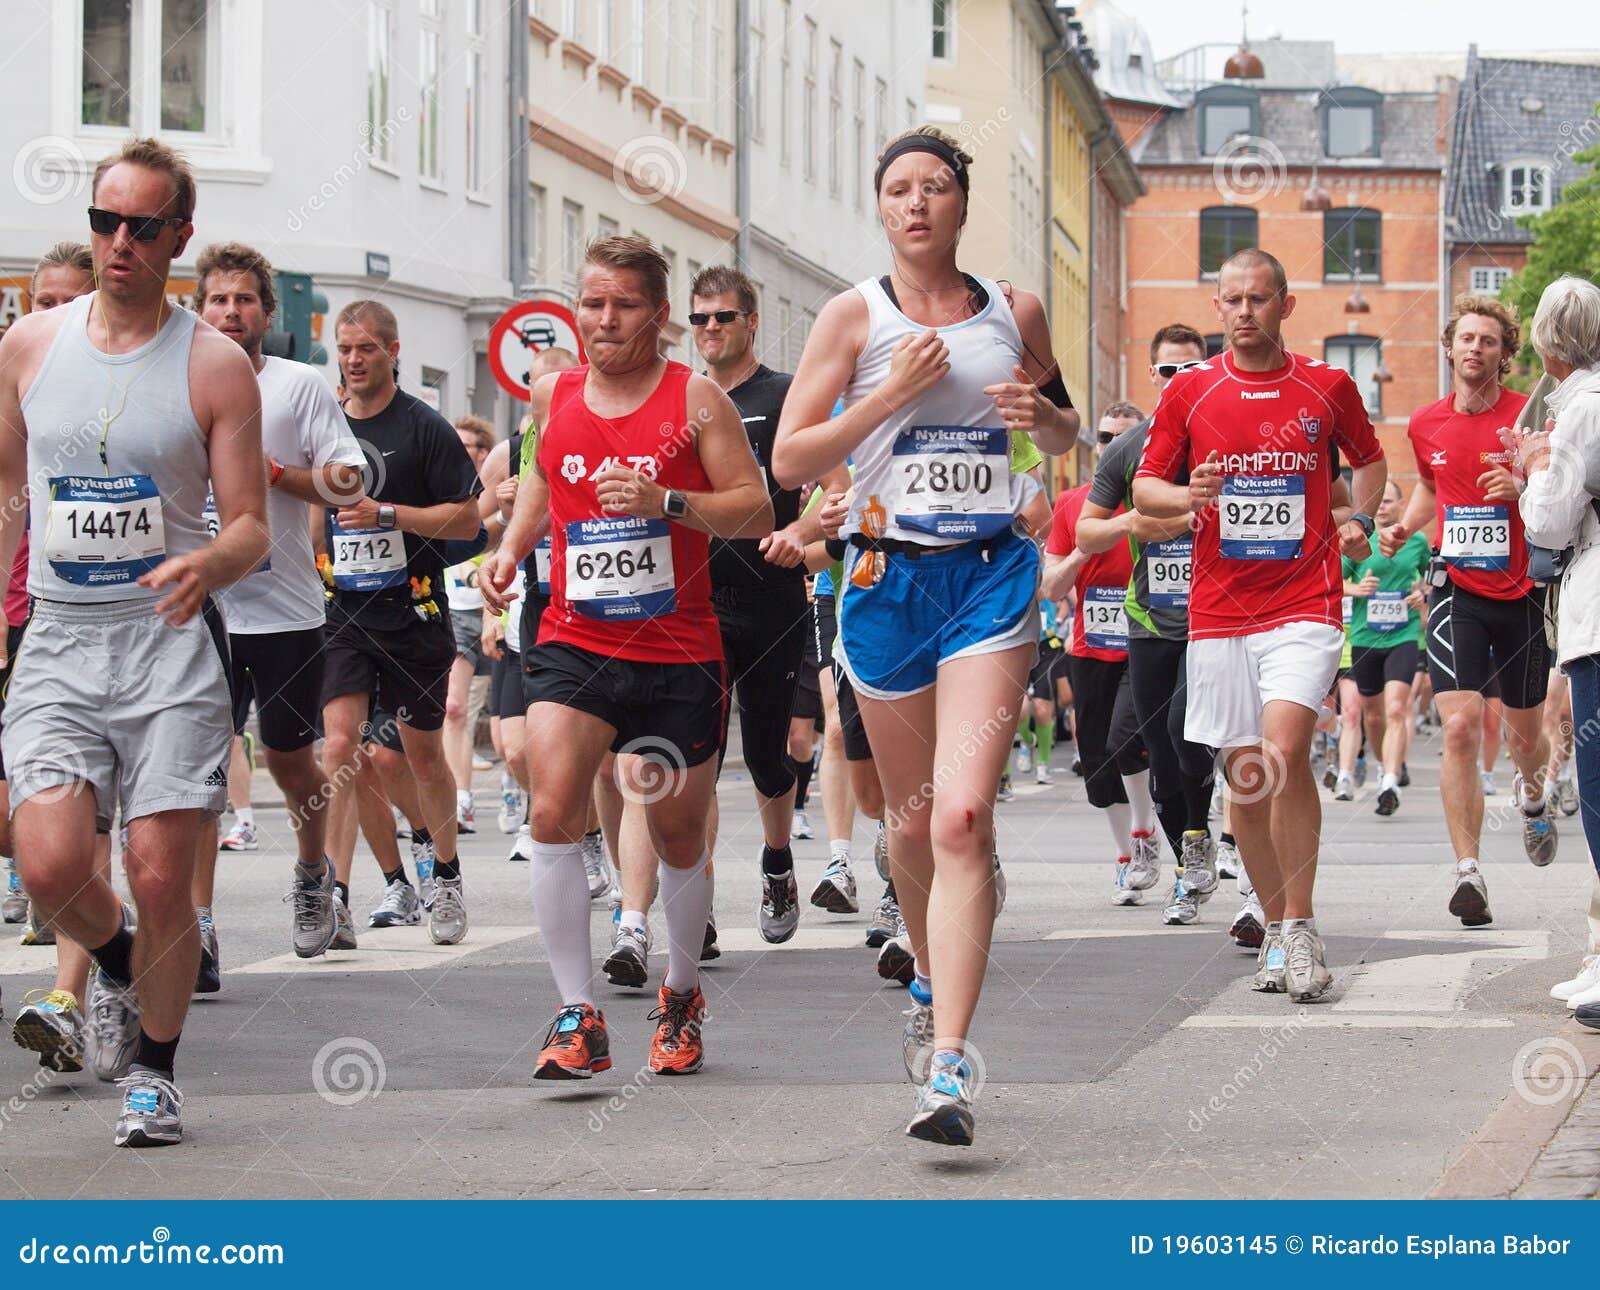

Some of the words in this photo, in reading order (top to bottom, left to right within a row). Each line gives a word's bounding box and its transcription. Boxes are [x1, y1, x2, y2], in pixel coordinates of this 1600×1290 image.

[1241, 390, 1280, 400] hummel
[915, 430, 990, 442] Nykredit
[1216, 452, 1319, 473] HAMPIONS
[69, 477, 137, 490] Nykredit
[905, 462, 992, 494] 2800
[1234, 478, 1288, 488] Nykredit
[1227, 502, 1291, 525] 9226
[1453, 506, 1495, 514] Nykredit
[68, 507, 151, 539] 14474
[581, 518, 648, 533] Nykredit
[937, 525, 977, 533] SPARTA
[583, 533, 617, 541] Copenhagen
[1448, 525, 1507, 544] 10783
[1160, 543, 1193, 552] Nykre
[577, 546, 656, 581] 6264
[88, 572, 130, 582] SPARTA
[1086, 606, 1121, 623] 137
